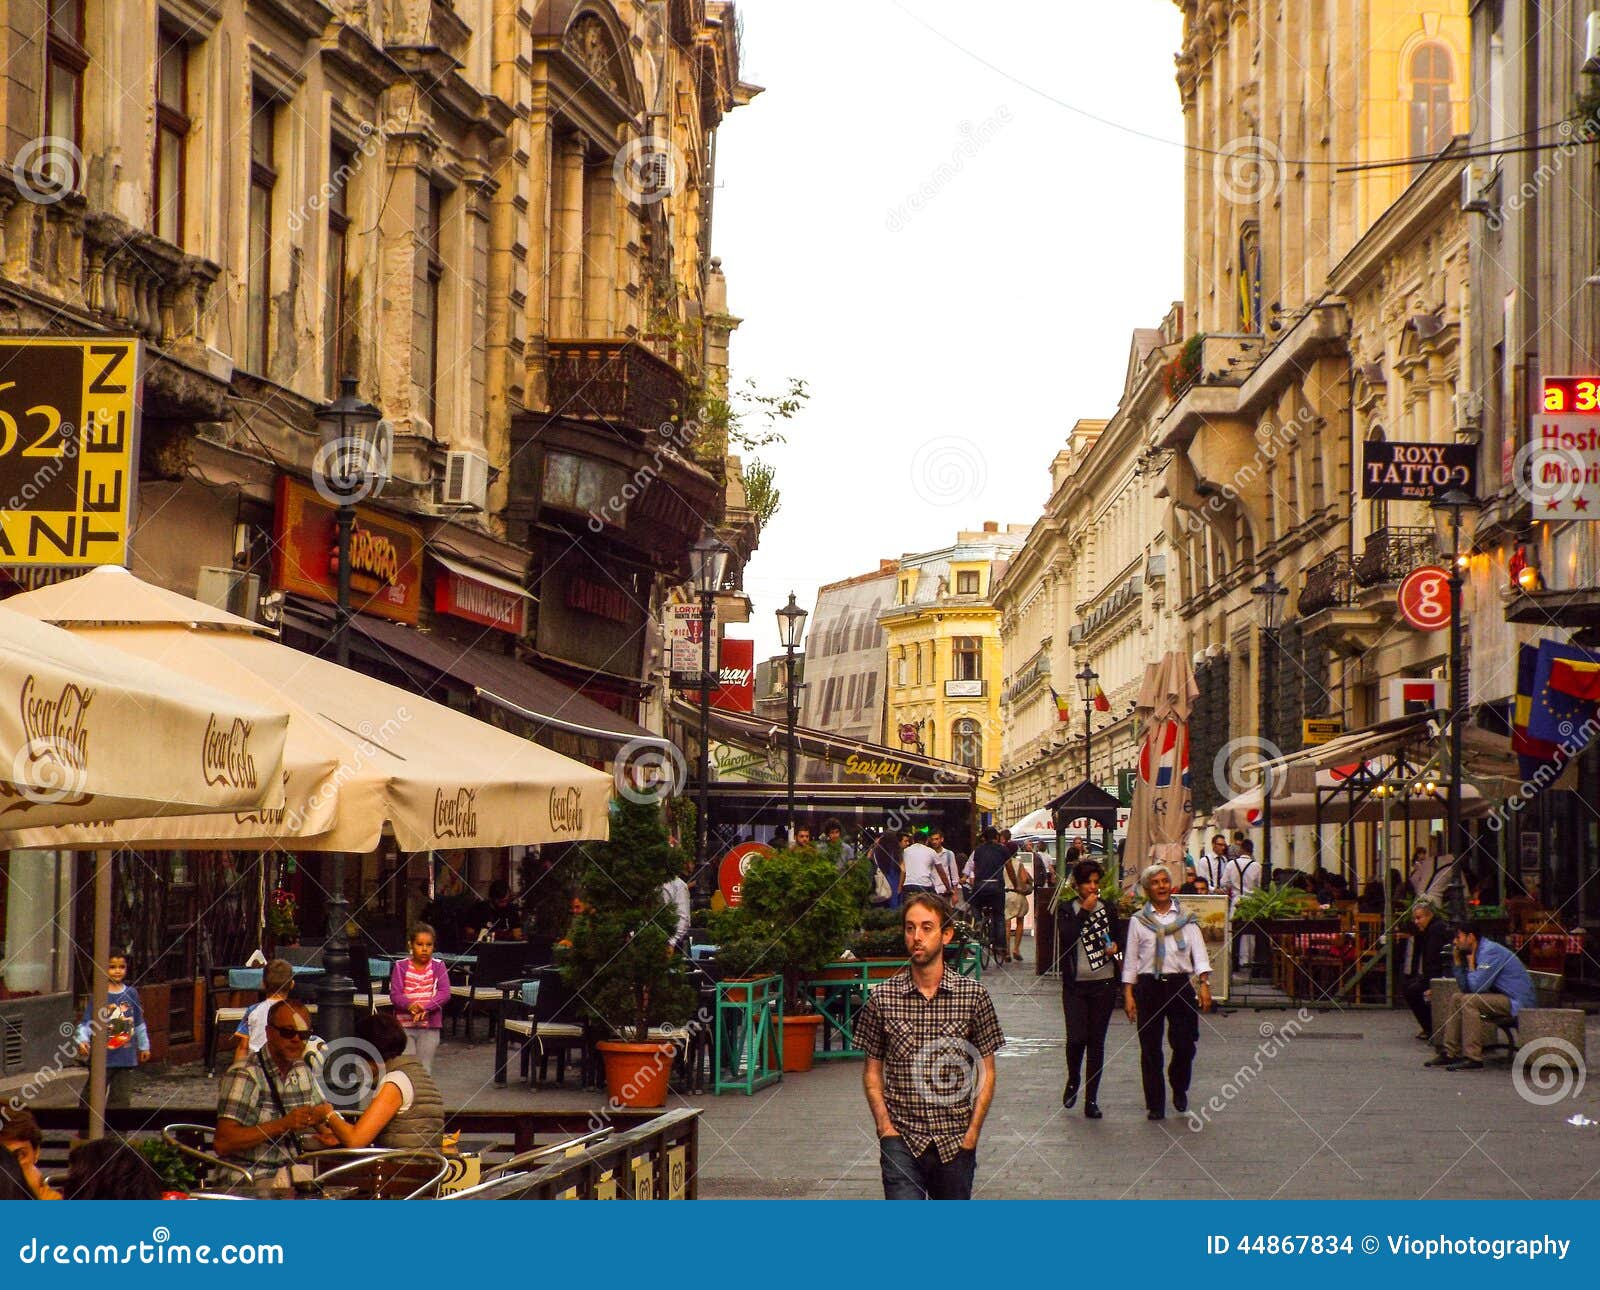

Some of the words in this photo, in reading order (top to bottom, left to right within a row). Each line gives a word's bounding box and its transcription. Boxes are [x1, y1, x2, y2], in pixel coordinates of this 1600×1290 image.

[1576, 381, 1600, 411] 3
[1542, 424, 1600, 451] Host
[1393, 446, 1446, 463] ROXY
[1368, 462, 1470, 485] TATTOO
[1542, 461, 1600, 485] Miori
[456, 577, 515, 625] MINIMARKET
[1418, 579, 1443, 618] g
[845, 754, 901, 783] Saray
